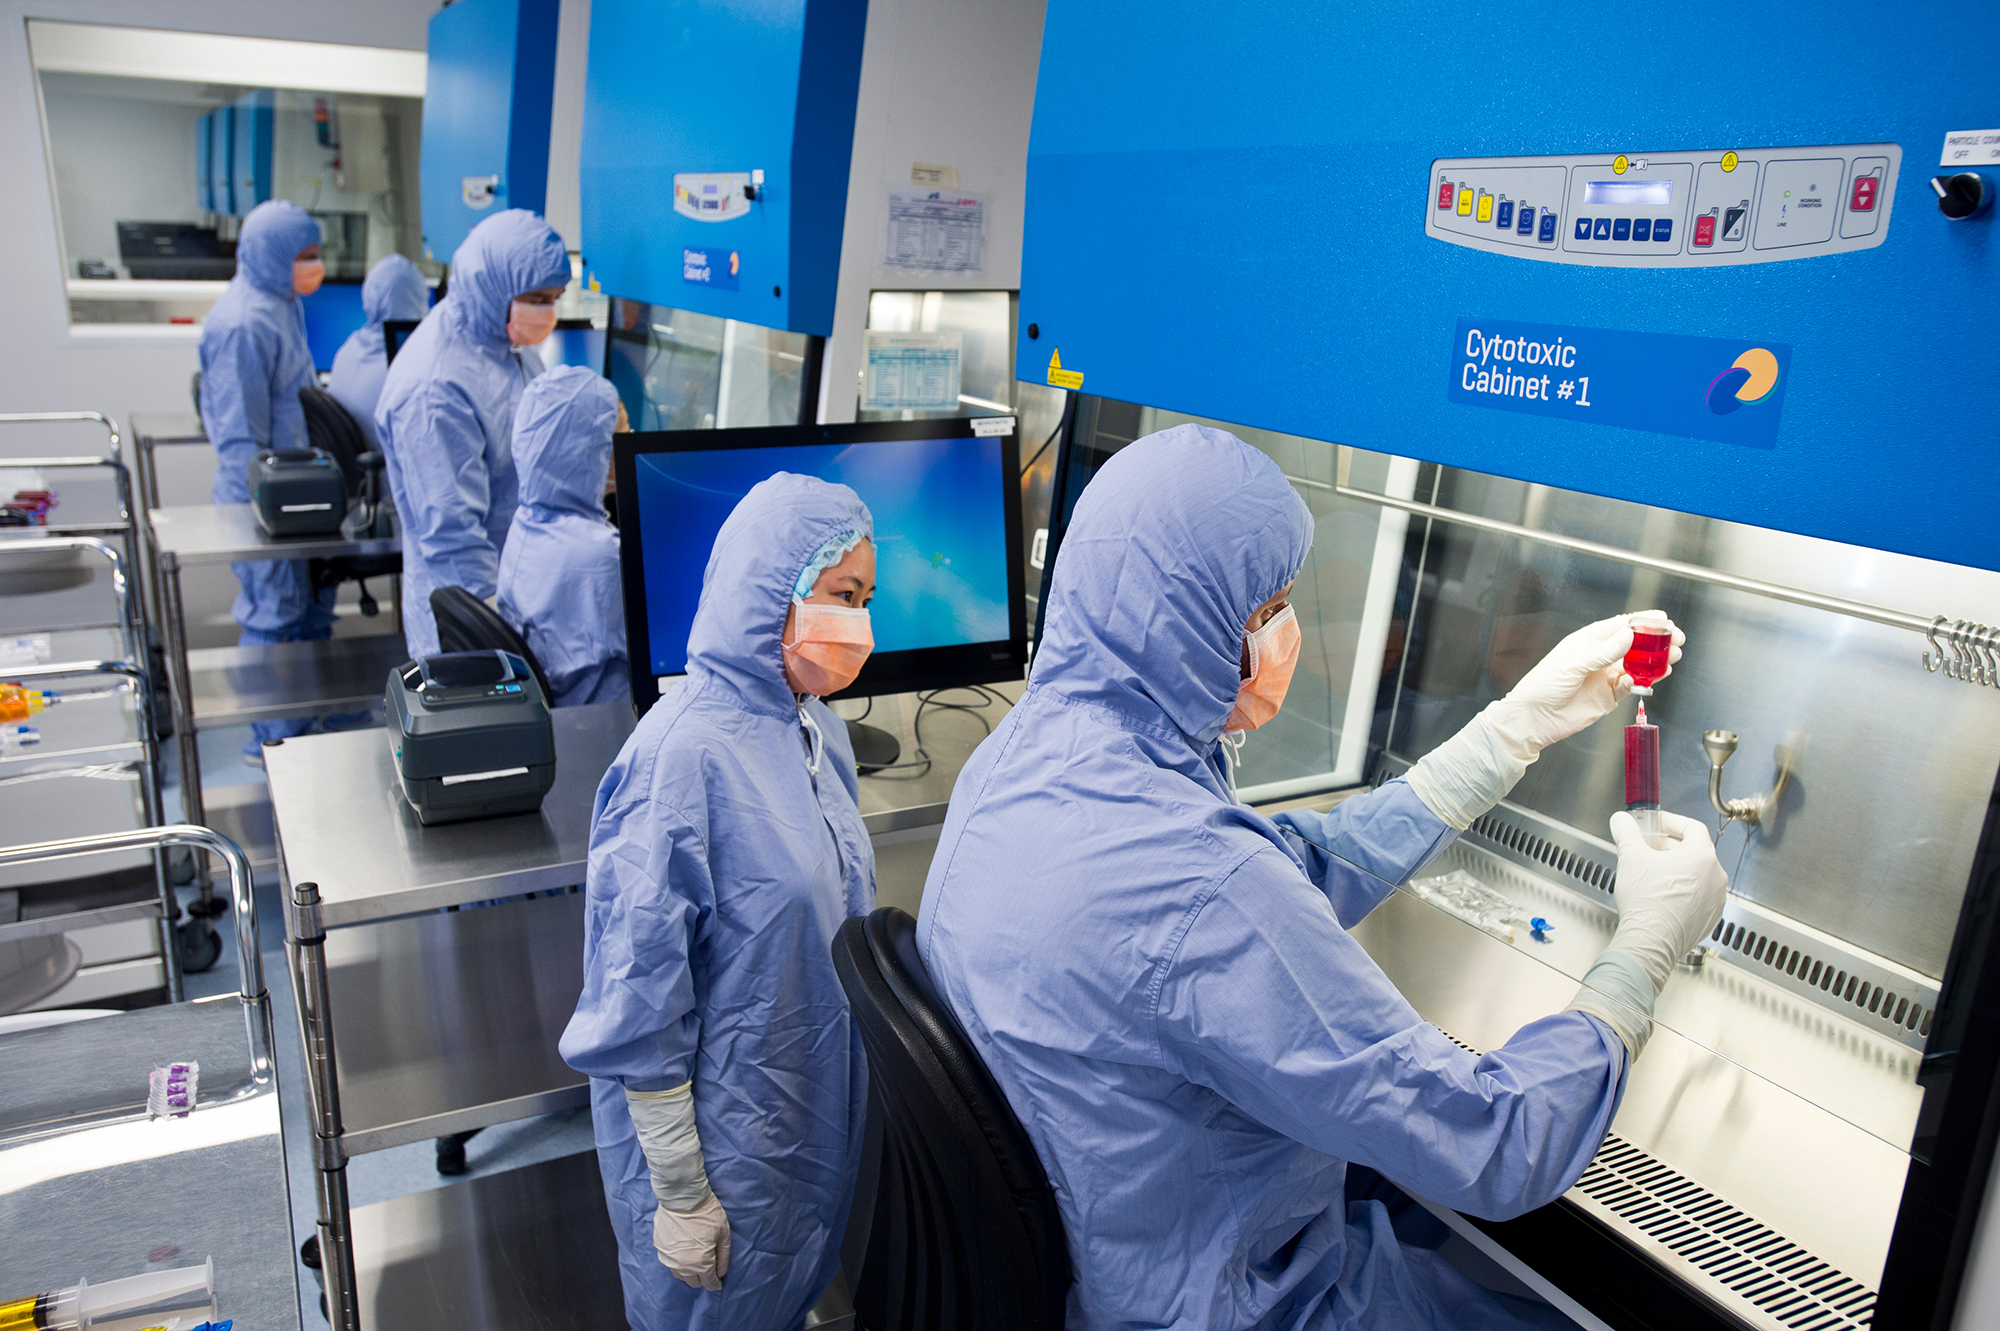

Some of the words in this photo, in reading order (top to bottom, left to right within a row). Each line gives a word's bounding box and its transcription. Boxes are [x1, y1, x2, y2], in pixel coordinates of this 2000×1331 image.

[1948, 136, 1980, 146] PARTICLE
[1953, 150, 1970, 159] OFF
[1466, 329, 1577, 368] Cytotoxic
[1462, 362, 1551, 401] Cabinet
[1557, 377, 1591, 407] #1
